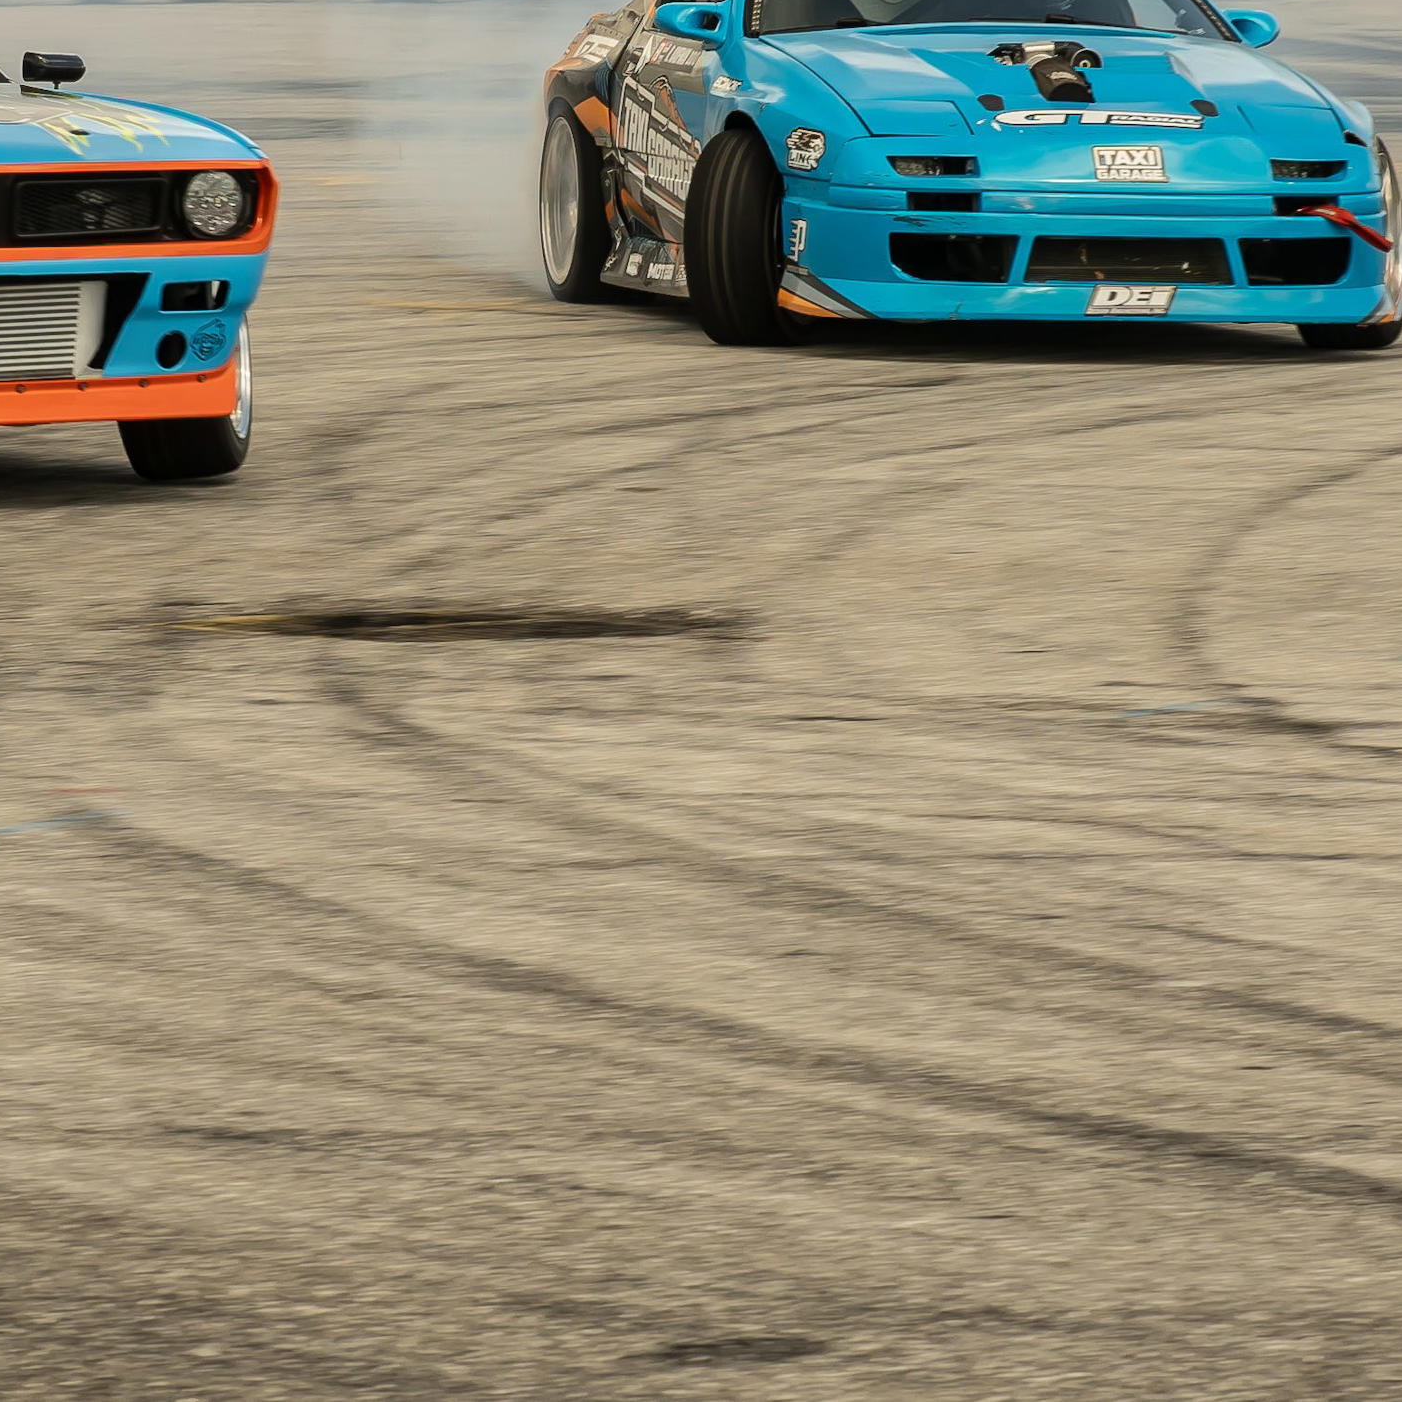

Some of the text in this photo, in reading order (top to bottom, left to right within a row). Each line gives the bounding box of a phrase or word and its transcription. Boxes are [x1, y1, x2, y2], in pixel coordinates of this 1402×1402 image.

[994, 109, 1111, 126] GT
[1099, 150, 1156, 167] TAXI
[1096, 168, 1165, 181] GARAGE
